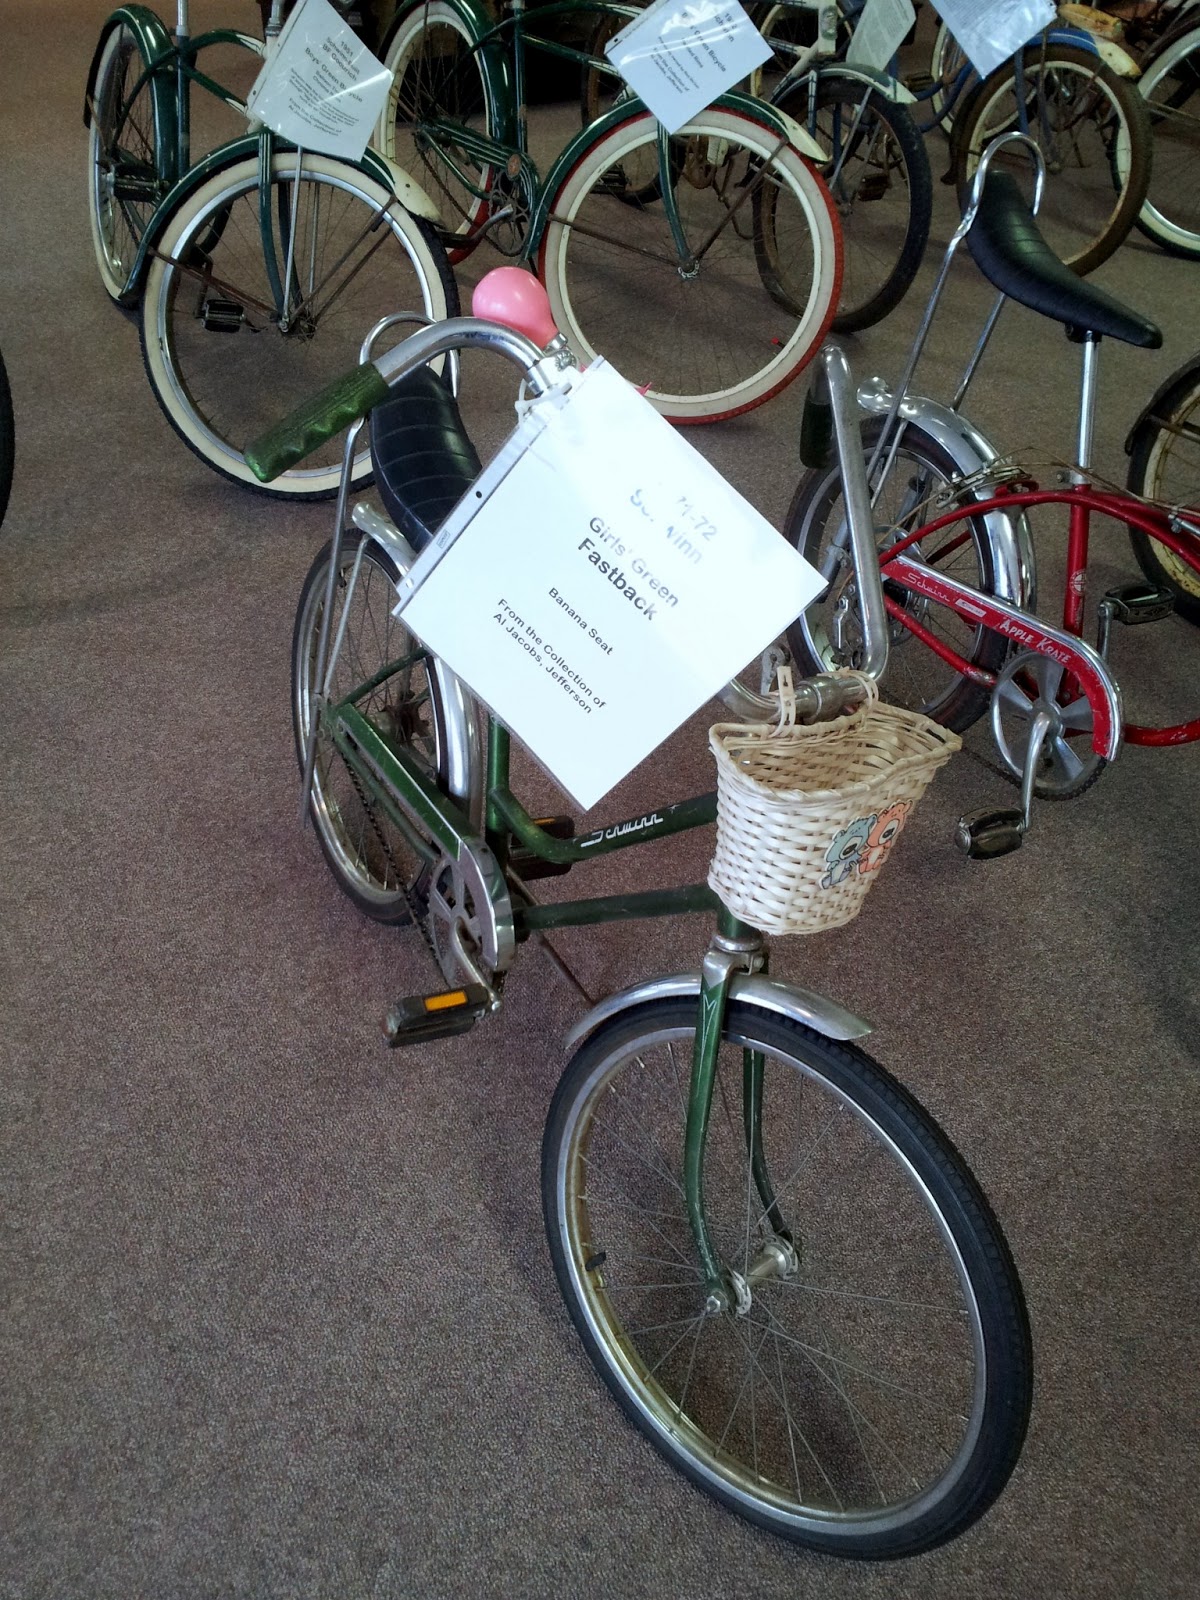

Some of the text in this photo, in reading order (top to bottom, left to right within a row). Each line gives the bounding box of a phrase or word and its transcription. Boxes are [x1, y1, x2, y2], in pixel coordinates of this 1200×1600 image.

[725, 12, 738, 31] 192
[321, 63, 339, 85] Green
[339, 81, 363, 103] Biycle
[708, 49, 727, 73] Bicycle
[577, 537, 658, 621] Fastback
[589, 516, 679, 608] Girls' Green
[902, 573, 950, 602] Schwinn
[548, 587, 614, 656] Banana Seat
[1000, 619, 1034, 643] APPLE
[493, 613, 593, 714] Al Jacobs, Jefferson
[497, 598, 607, 709] From the Collection of
